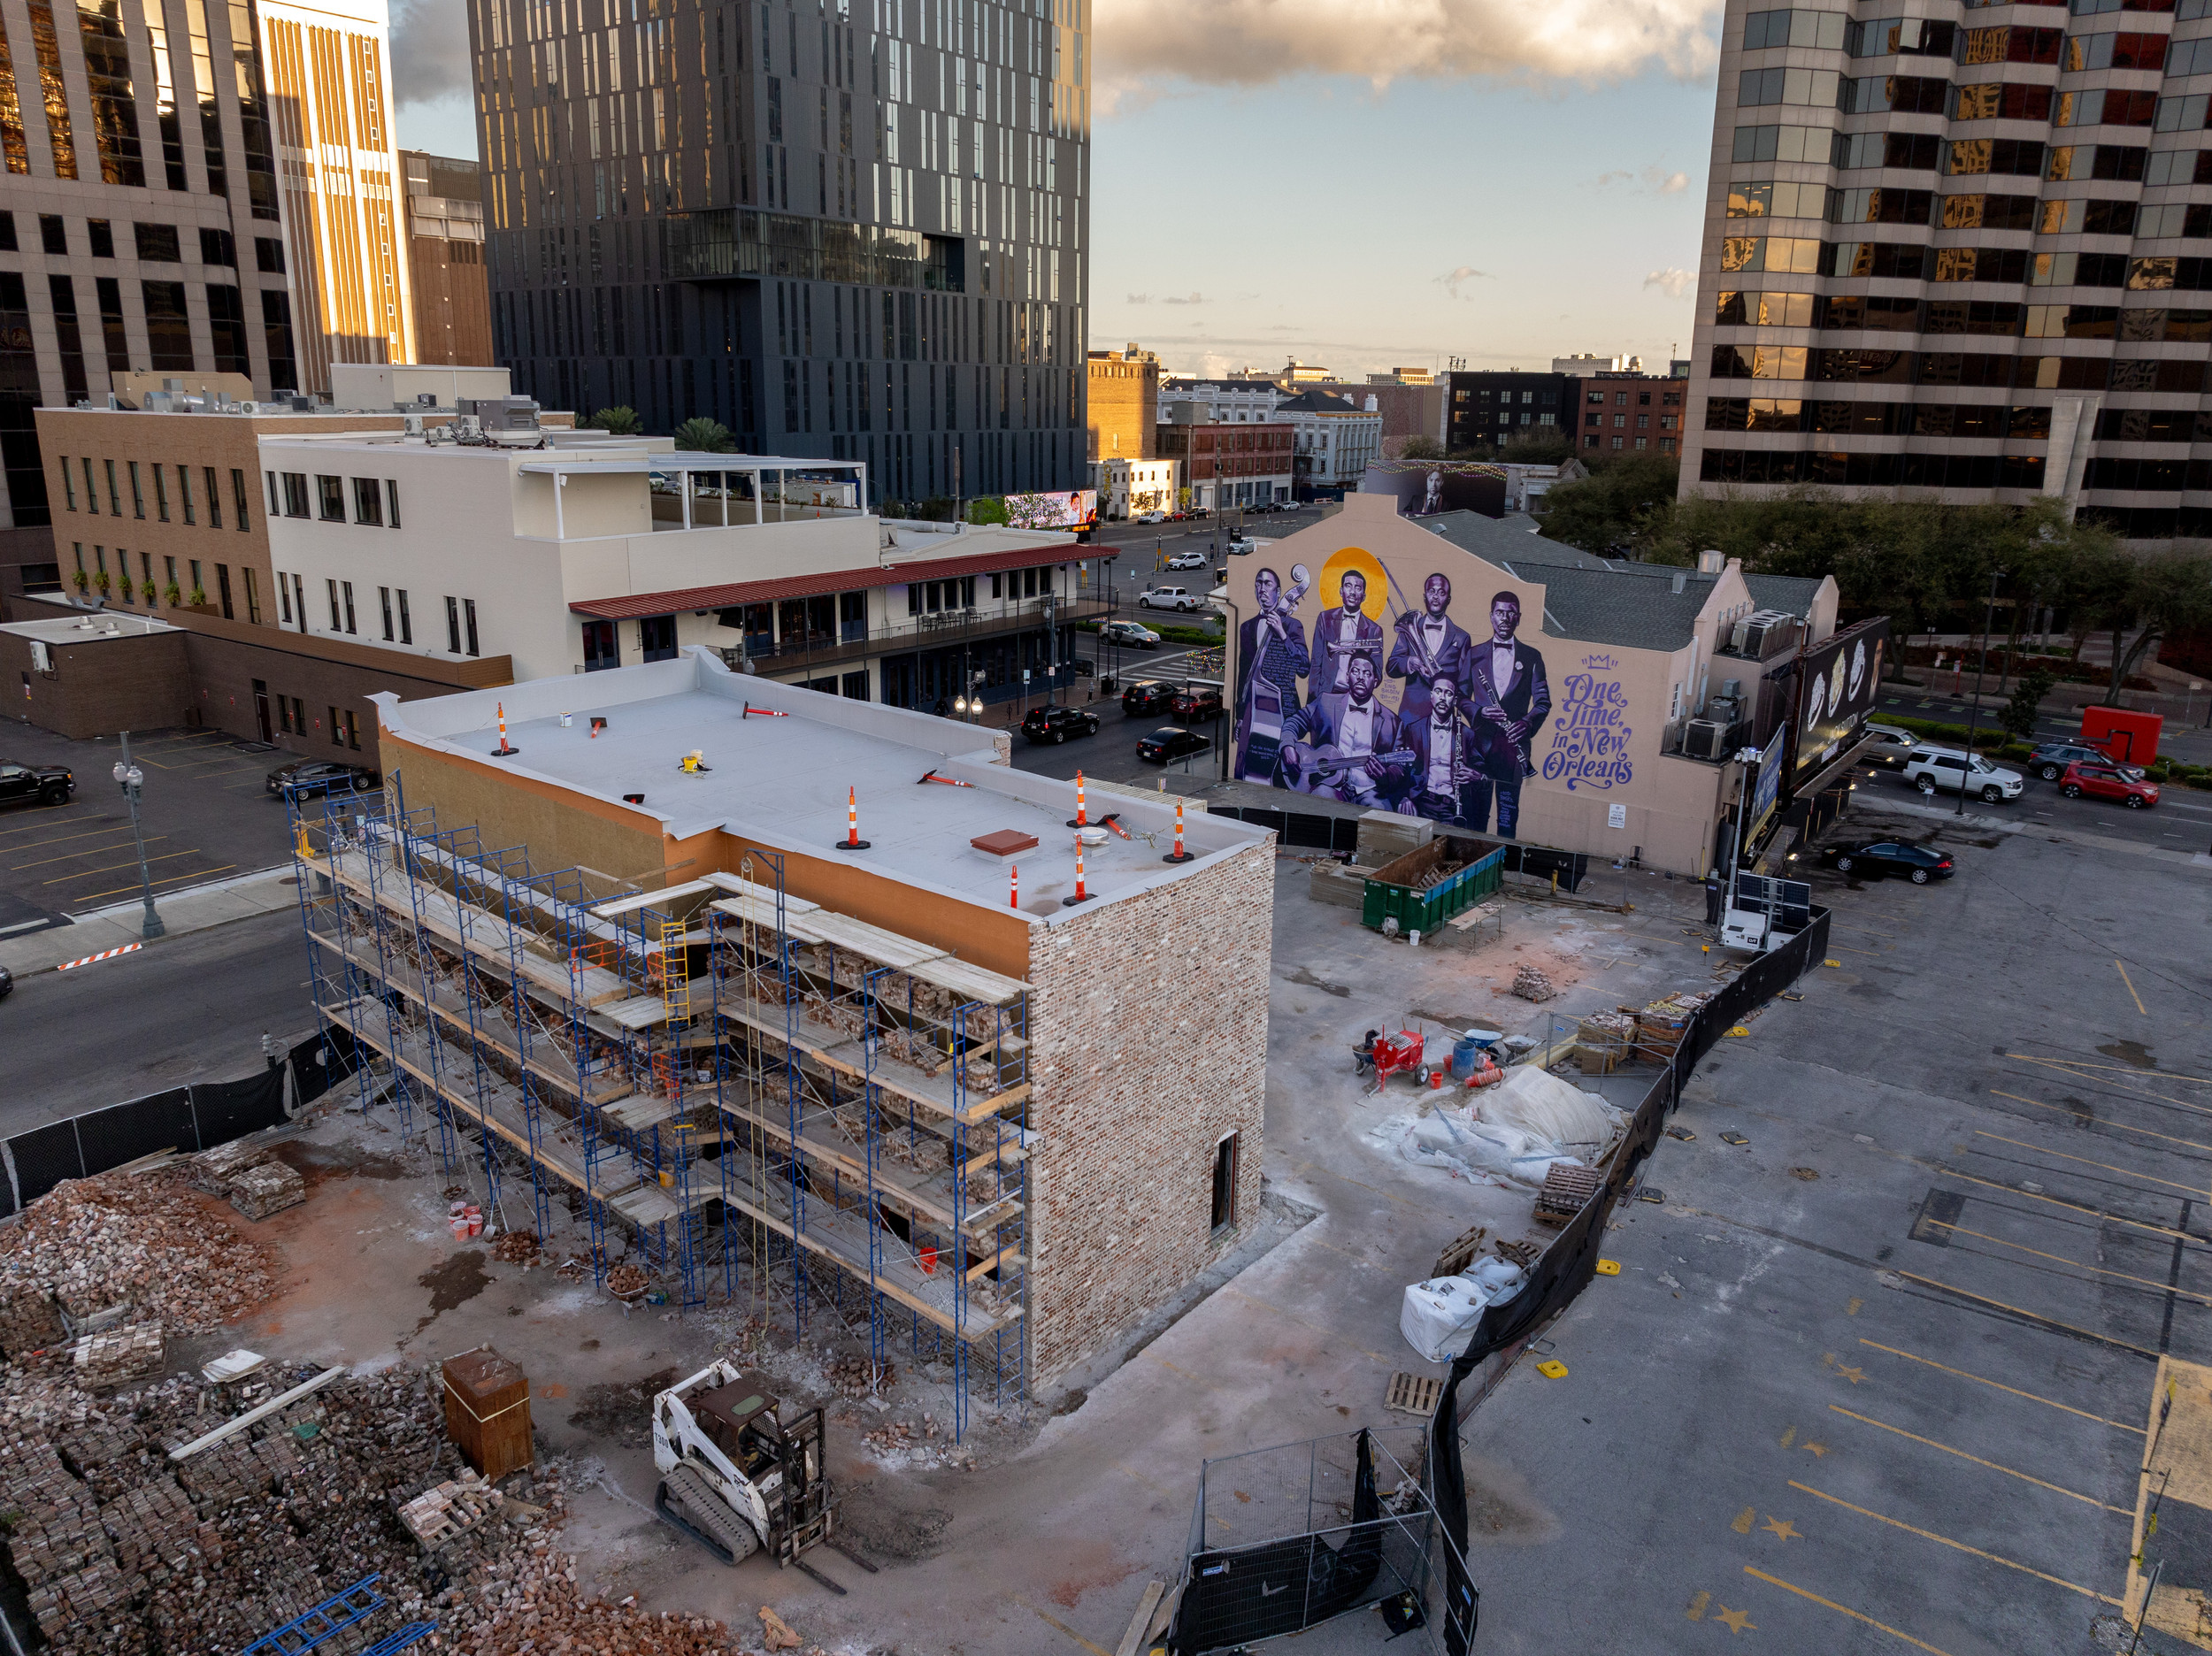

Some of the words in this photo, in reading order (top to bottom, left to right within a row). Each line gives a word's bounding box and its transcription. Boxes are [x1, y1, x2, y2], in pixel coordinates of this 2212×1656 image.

[1564, 673, 1628, 708] One
[1551, 732, 1568, 748] in
[1567, 727, 1632, 761] New
[1542, 750, 1633, 786] Orleans
[654, 1431, 669, 1448] T300
